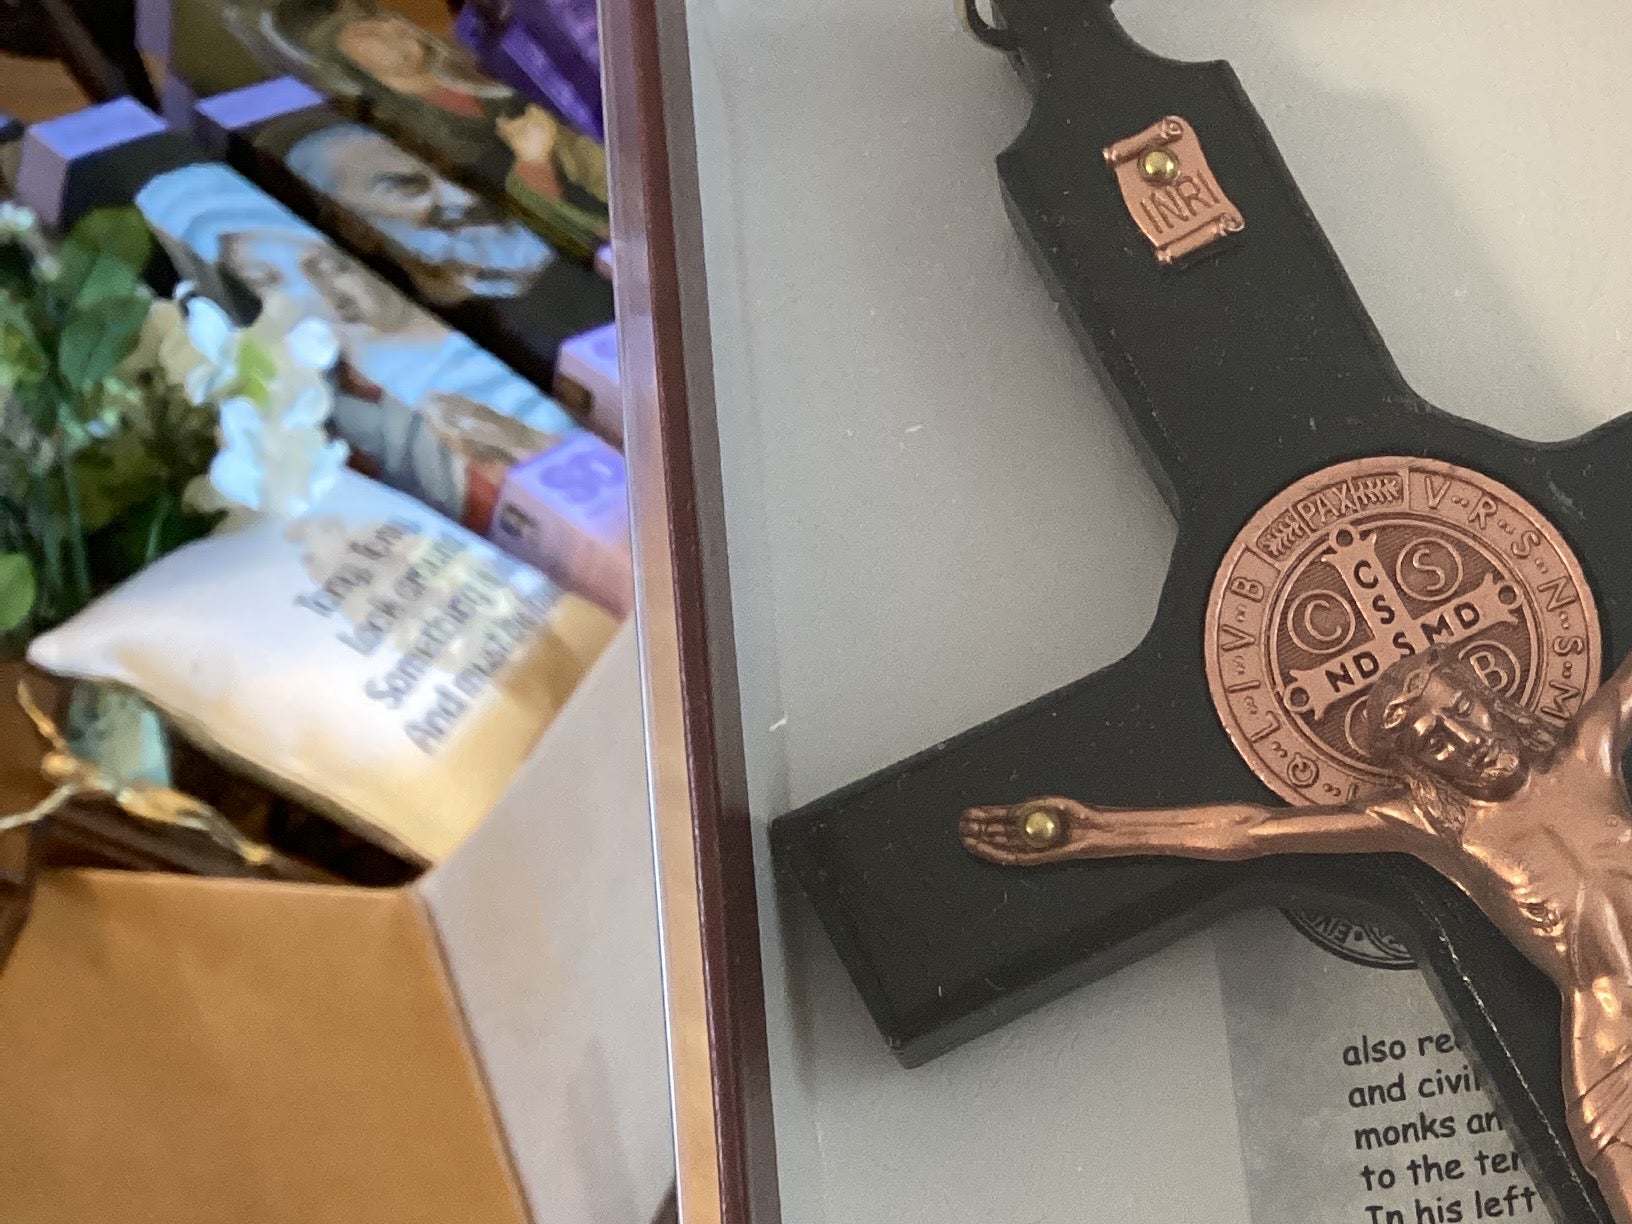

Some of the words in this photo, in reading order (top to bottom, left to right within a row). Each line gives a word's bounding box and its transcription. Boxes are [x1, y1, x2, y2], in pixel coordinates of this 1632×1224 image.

[1138, 168, 1221, 235] INRI
[1299, 486, 1360, 534] PAX
[1343, 1035, 1406, 1066] also
[1348, 1072, 1406, 1108] and
[1354, 1112, 1456, 1151] monks
[1360, 1163, 1396, 1192] to
[1406, 1154, 1466, 1186] the
[1475, 1185, 1534, 1219] left
